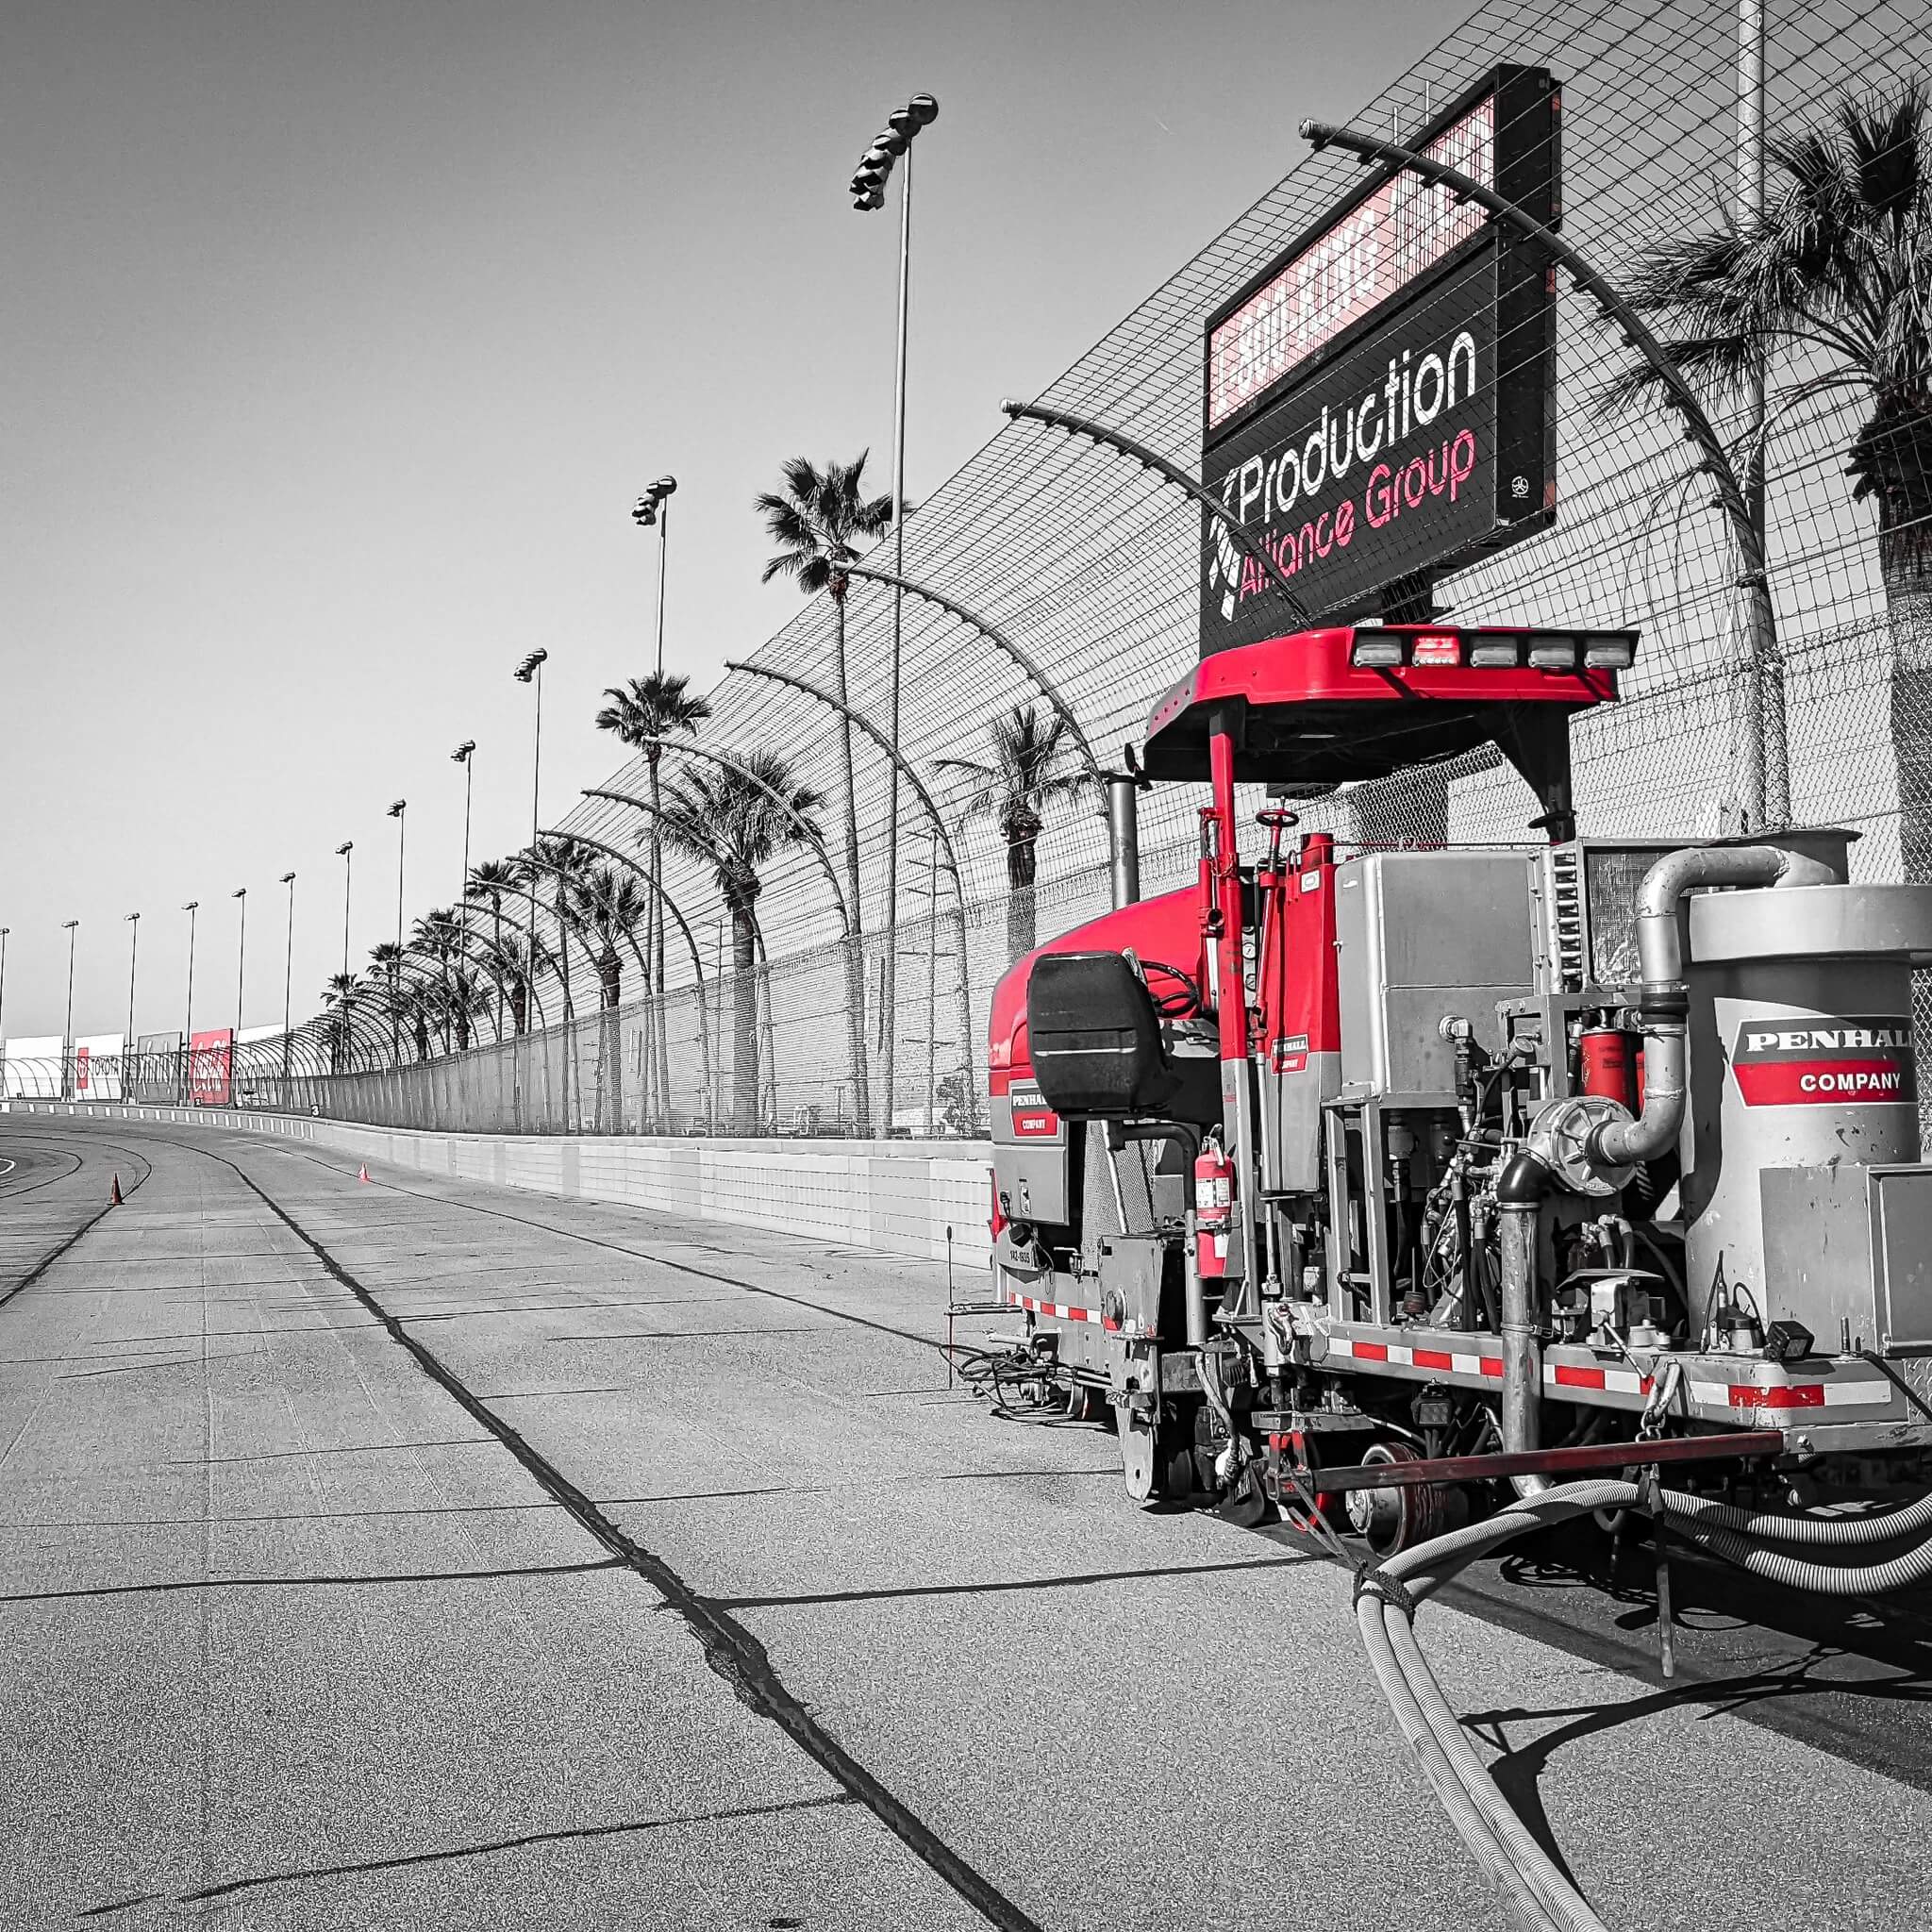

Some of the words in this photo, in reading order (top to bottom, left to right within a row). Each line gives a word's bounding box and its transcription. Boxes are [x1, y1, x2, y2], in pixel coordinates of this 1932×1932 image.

[1239, 331, 1475, 526] Production
[1239, 500, 1355, 604] Alliance
[1365, 428, 1475, 528] Group
[311, 1105, 319, 1116] 3
[1800, 1073, 1901, 1092] COMPANY
